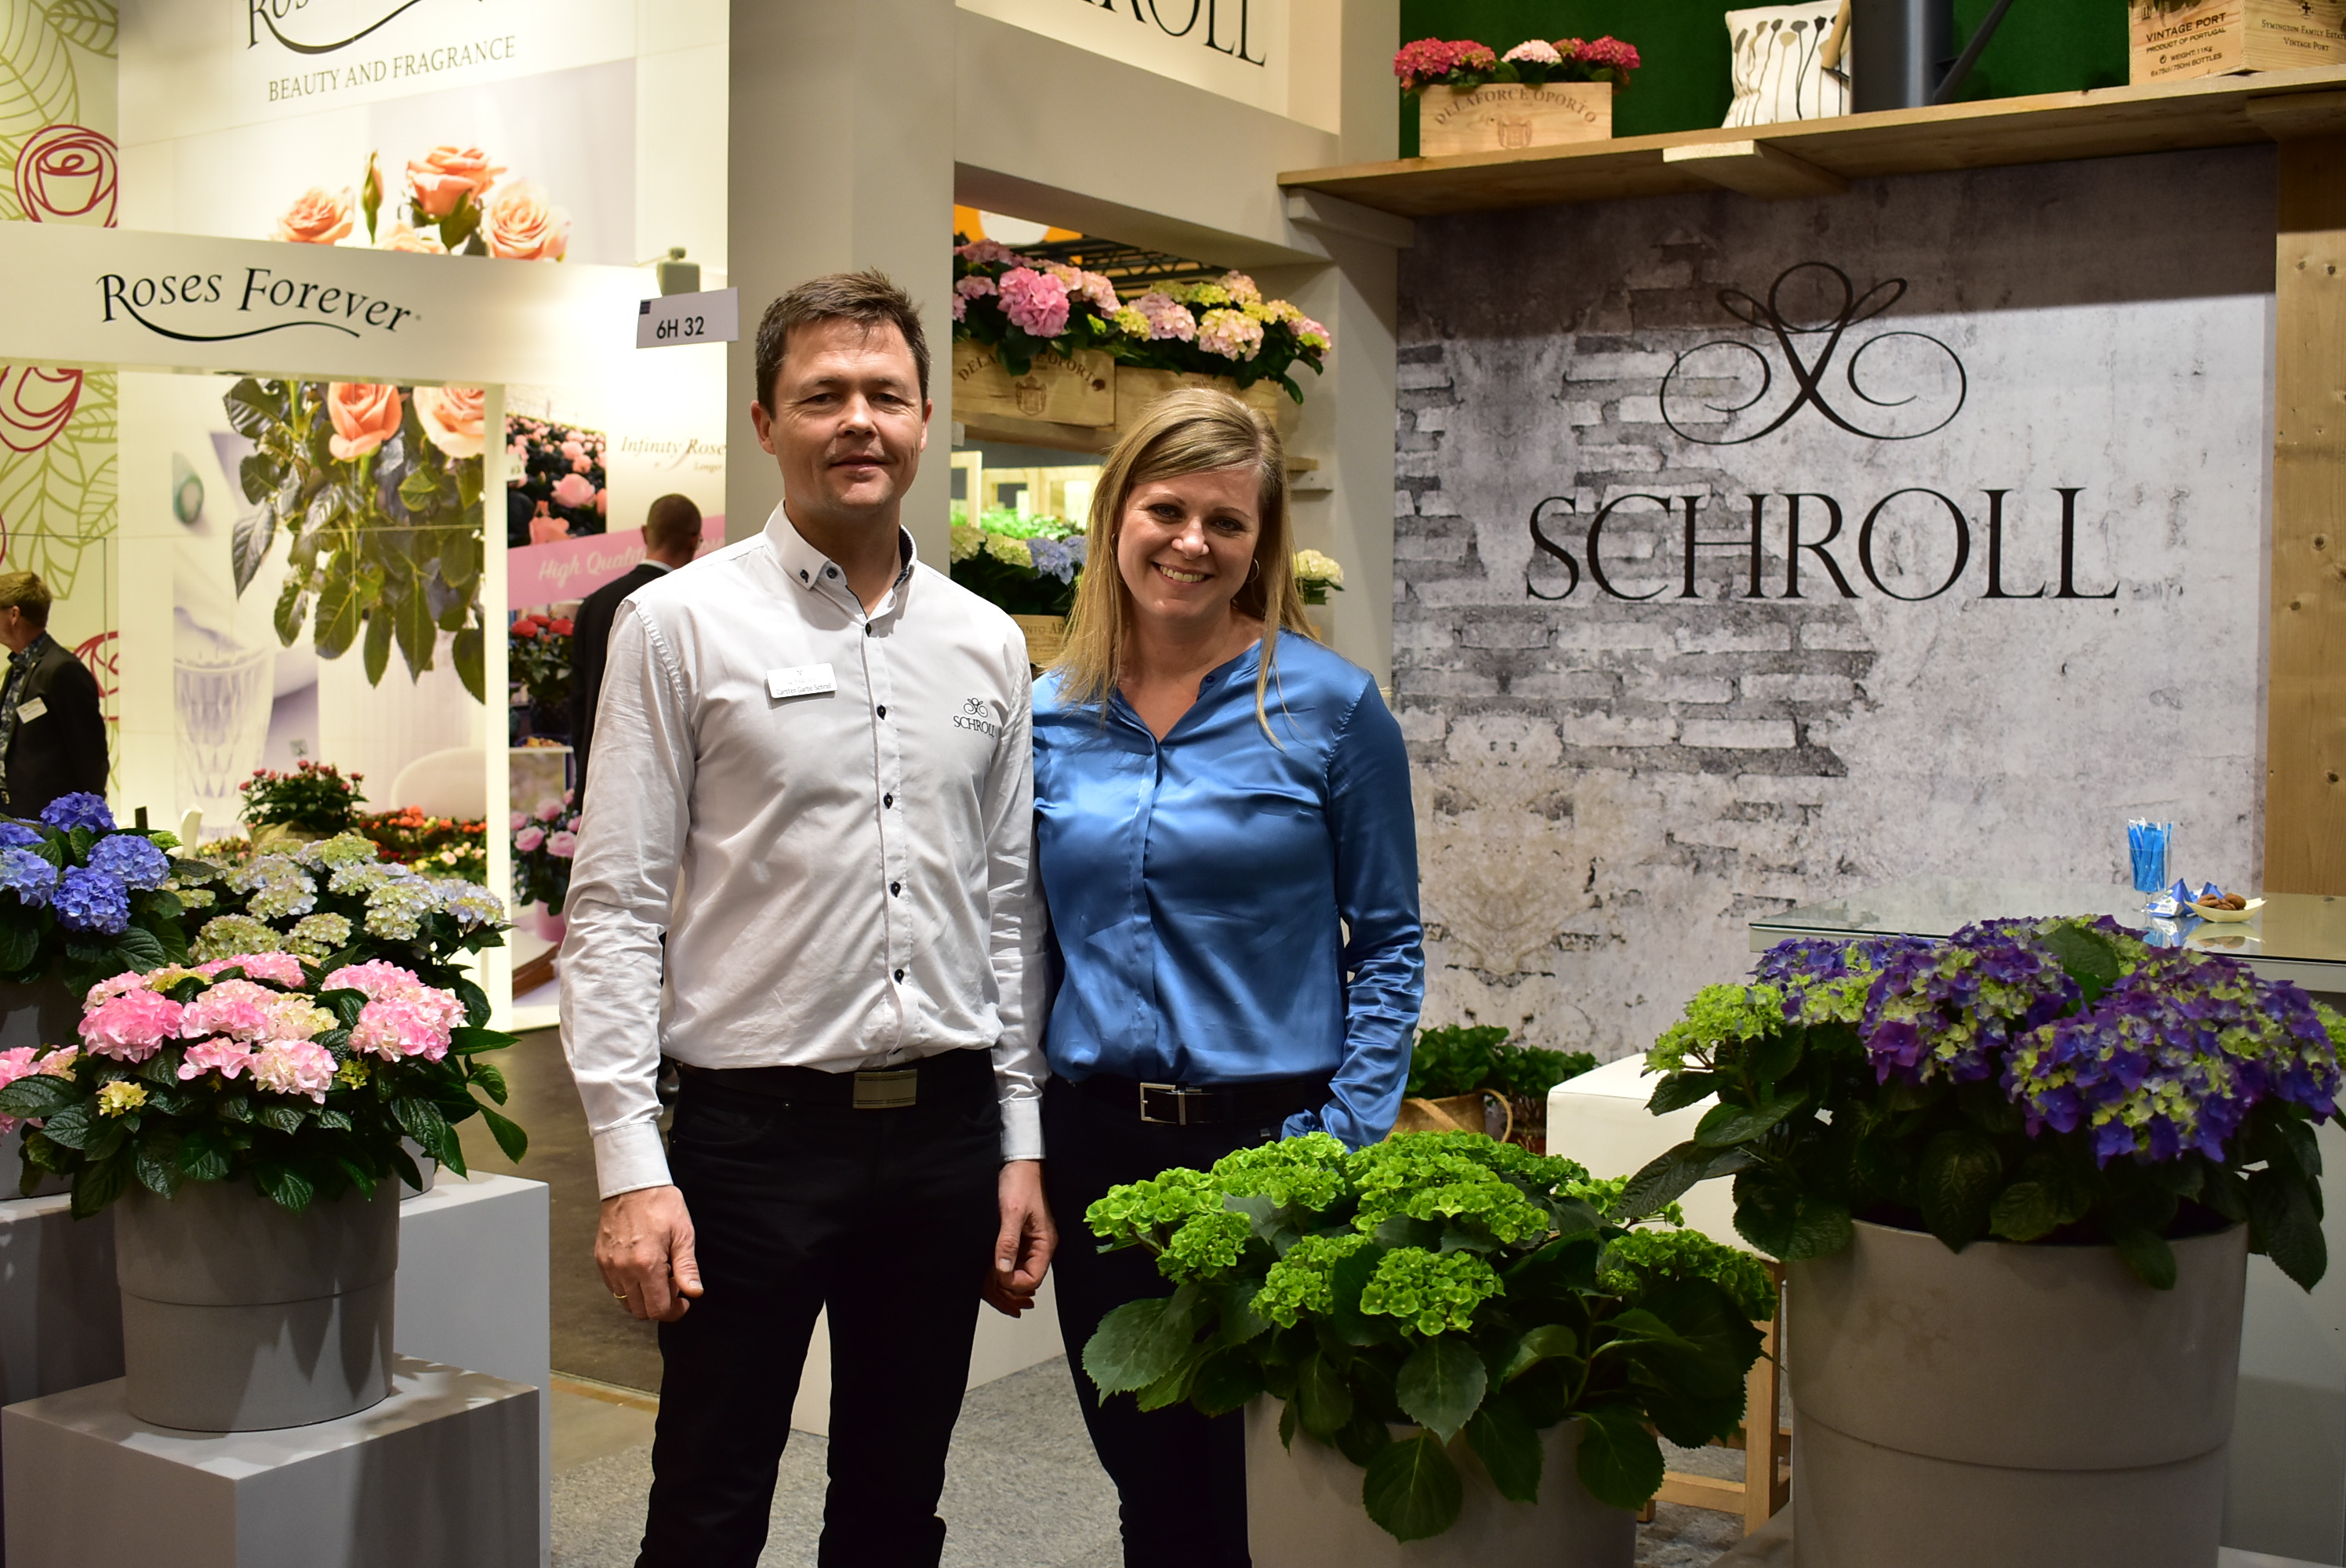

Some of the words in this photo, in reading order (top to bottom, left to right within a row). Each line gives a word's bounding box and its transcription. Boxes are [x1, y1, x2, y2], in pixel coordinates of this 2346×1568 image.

[2146, 22, 2193, 42] VINTAGE
[2195, 13, 2226, 28] PORT
[2146, 40, 2177, 53] PRODUCT
[2179, 36, 2189, 45] OF
[2190, 27, 2226, 42] PORTUGAL
[2261, 20, 2299, 32] SYMINGTON
[2301, 25, 2323, 36] FAMILY
[2283, 37, 2312, 49] VINTAGE
[2313, 41, 2330, 51] PORT
[268, 68, 340, 102] BEAUTY
[345, 60, 387, 88] AND
[393, 35, 516, 78] FRAGRANCE
[2192, 53, 2222, 66] BOTTLES
[1434, 88, 1529, 125] DELAFORCE
[1534, 89, 1596, 123] OPORTO
[96, 273, 222, 323] Roses
[238, 267, 412, 332] Forever
[656, 318, 678, 339] 6H
[684, 316, 705, 336] 32
[621, 436, 684, 458] Infinity
[1526, 487, 2119, 601] SCHROLL
[539, 553, 580, 588] High
[587, 546, 648, 575] Qualit
[953, 715, 995, 738] SCHROLL
